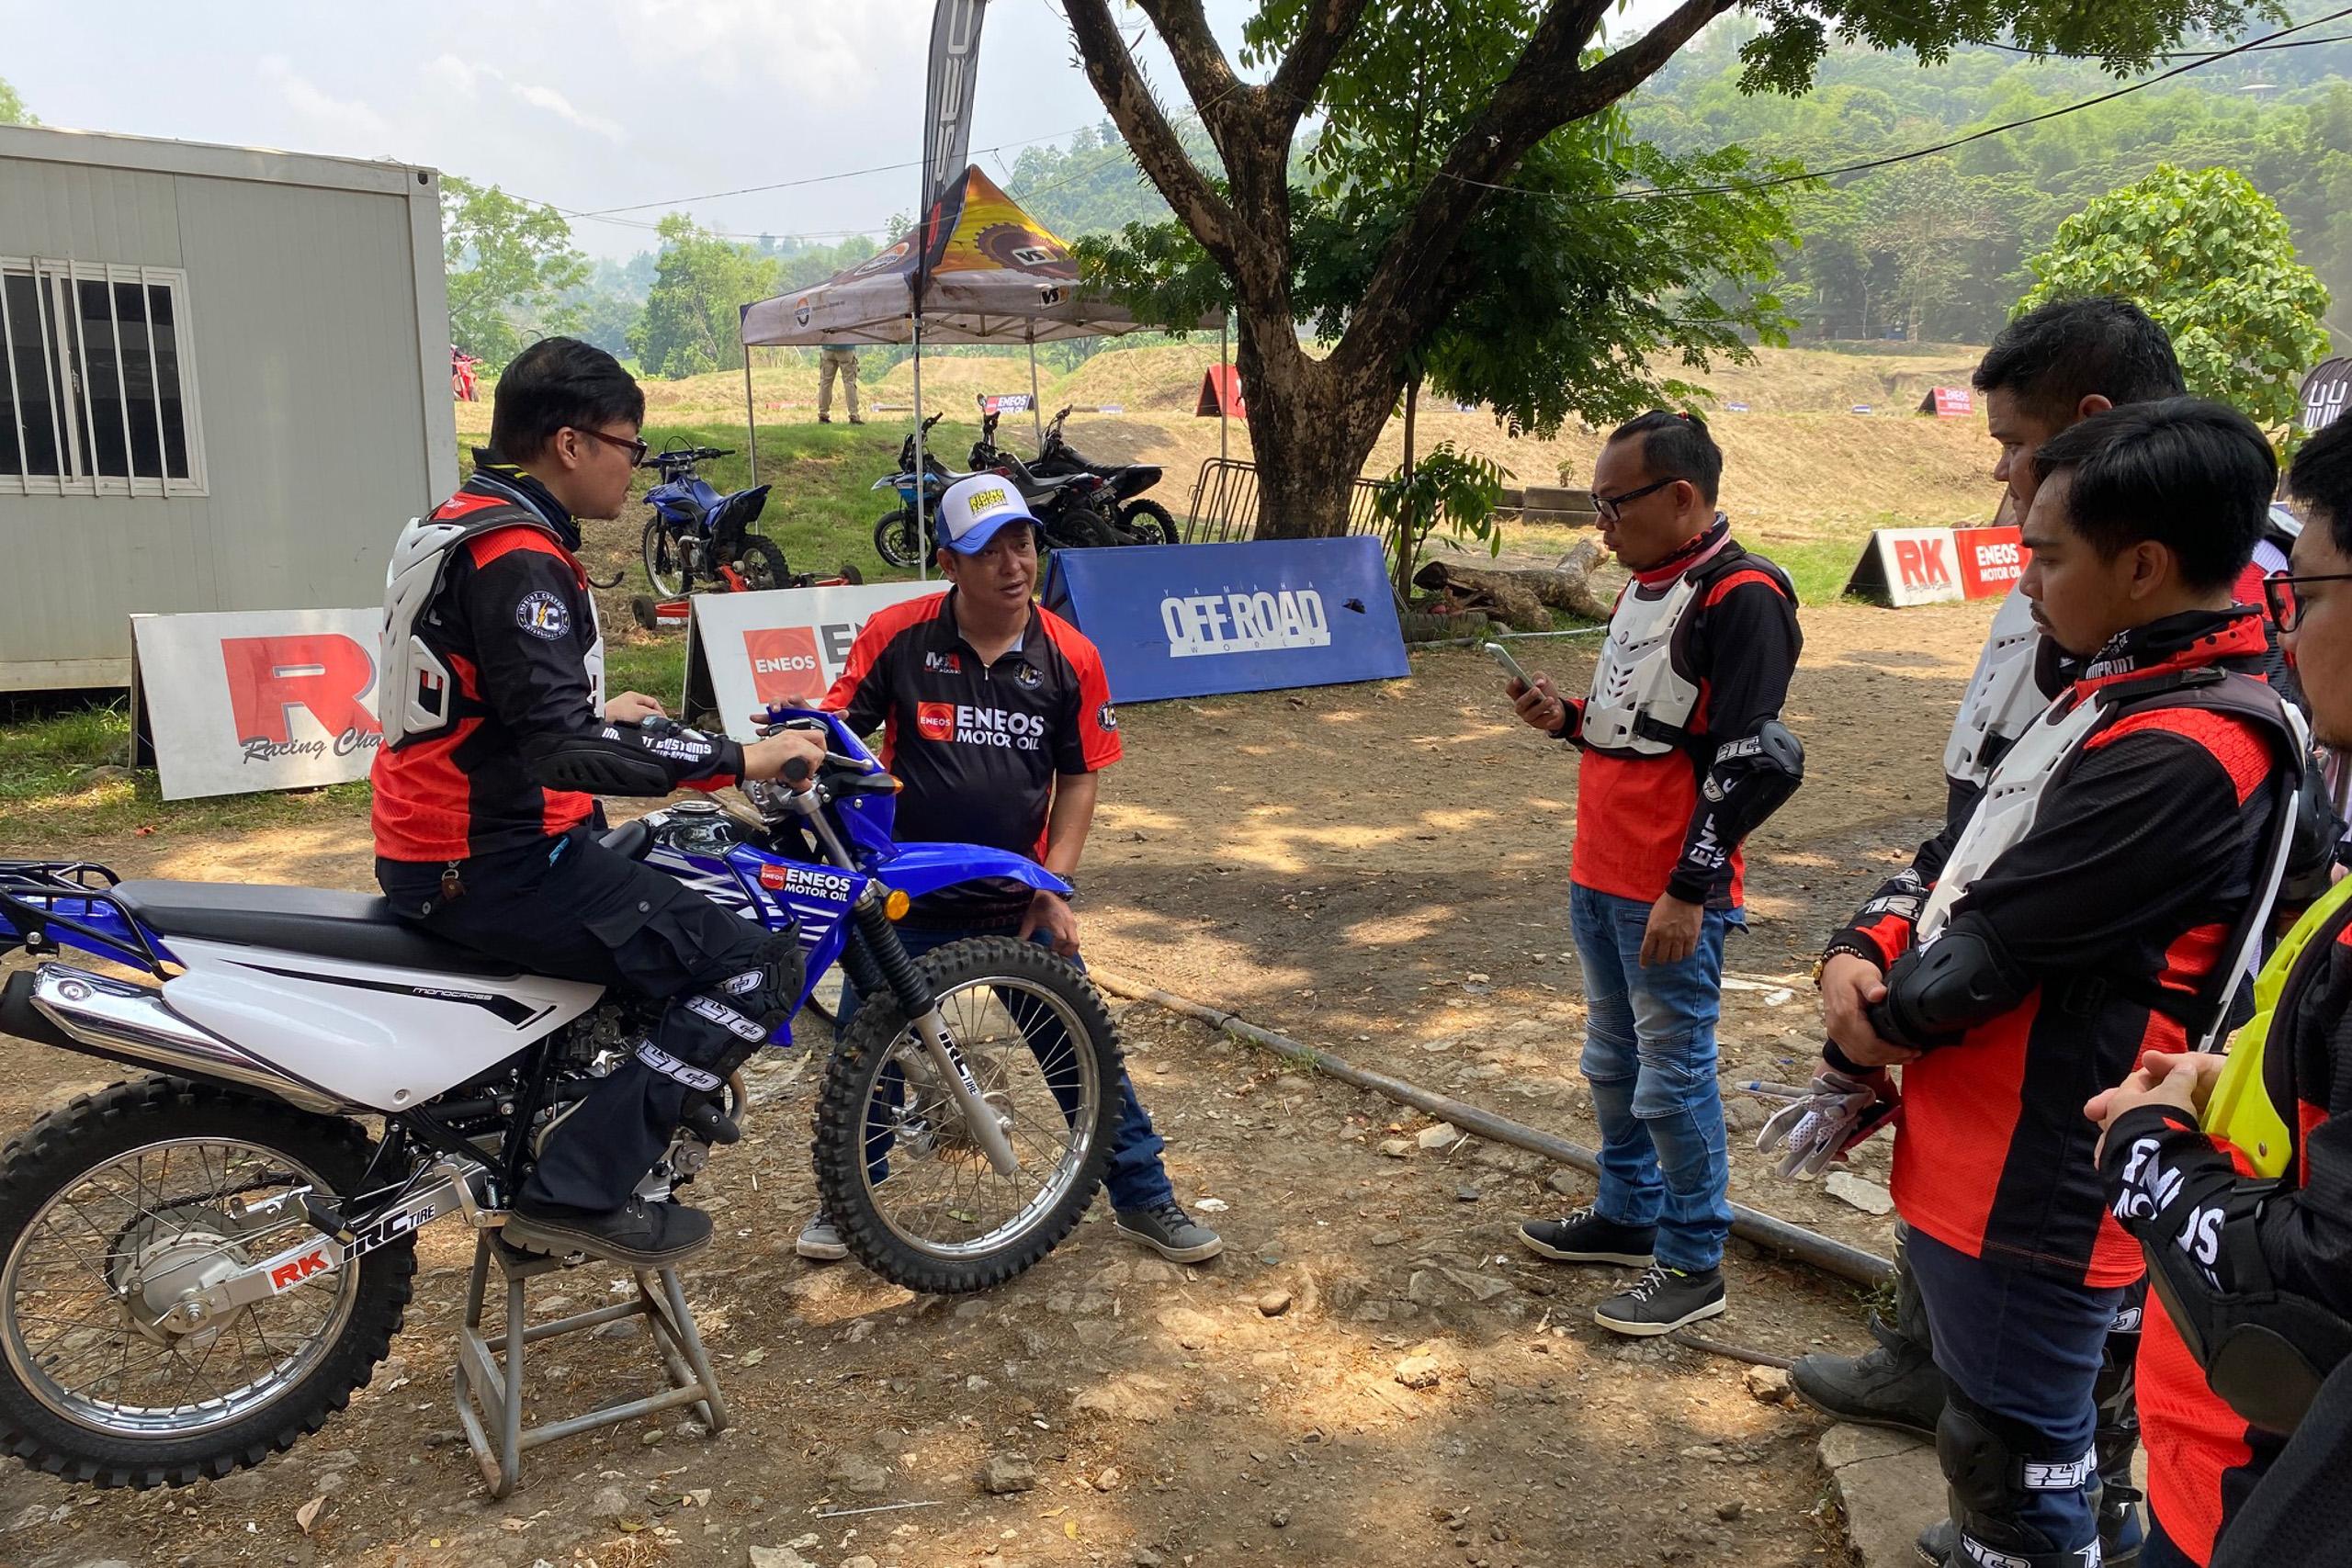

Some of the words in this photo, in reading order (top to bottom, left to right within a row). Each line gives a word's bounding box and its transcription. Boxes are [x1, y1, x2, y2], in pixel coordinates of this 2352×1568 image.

[999, 396, 1027, 407] ENEOS
[1894, 538, 1951, 585] RK
[1976, 543, 2019, 566] ENEOS
[1981, 566, 2009, 581] MOTOR
[1163, 581, 1315, 597] YAMAHA
[754, 655, 816, 673] ENEOS
[920, 716, 952, 727] ENEOS
[956, 705, 1044, 737] ENEOS
[243, 736, 326, 764] Racing
[334, 727, 382, 757] Cha
[956, 729, 1011, 749] MOTOR
[1016, 737, 1039, 750] OIL
[762, 872, 784, 881] ENEOS
[786, 868, 852, 892] ENEOS
[784, 883, 827, 899] MOTOR
[830, 890, 849, 902] OIL
[409, 1204, 435, 1228] TIRE
[271, 1249, 329, 1289] RK
